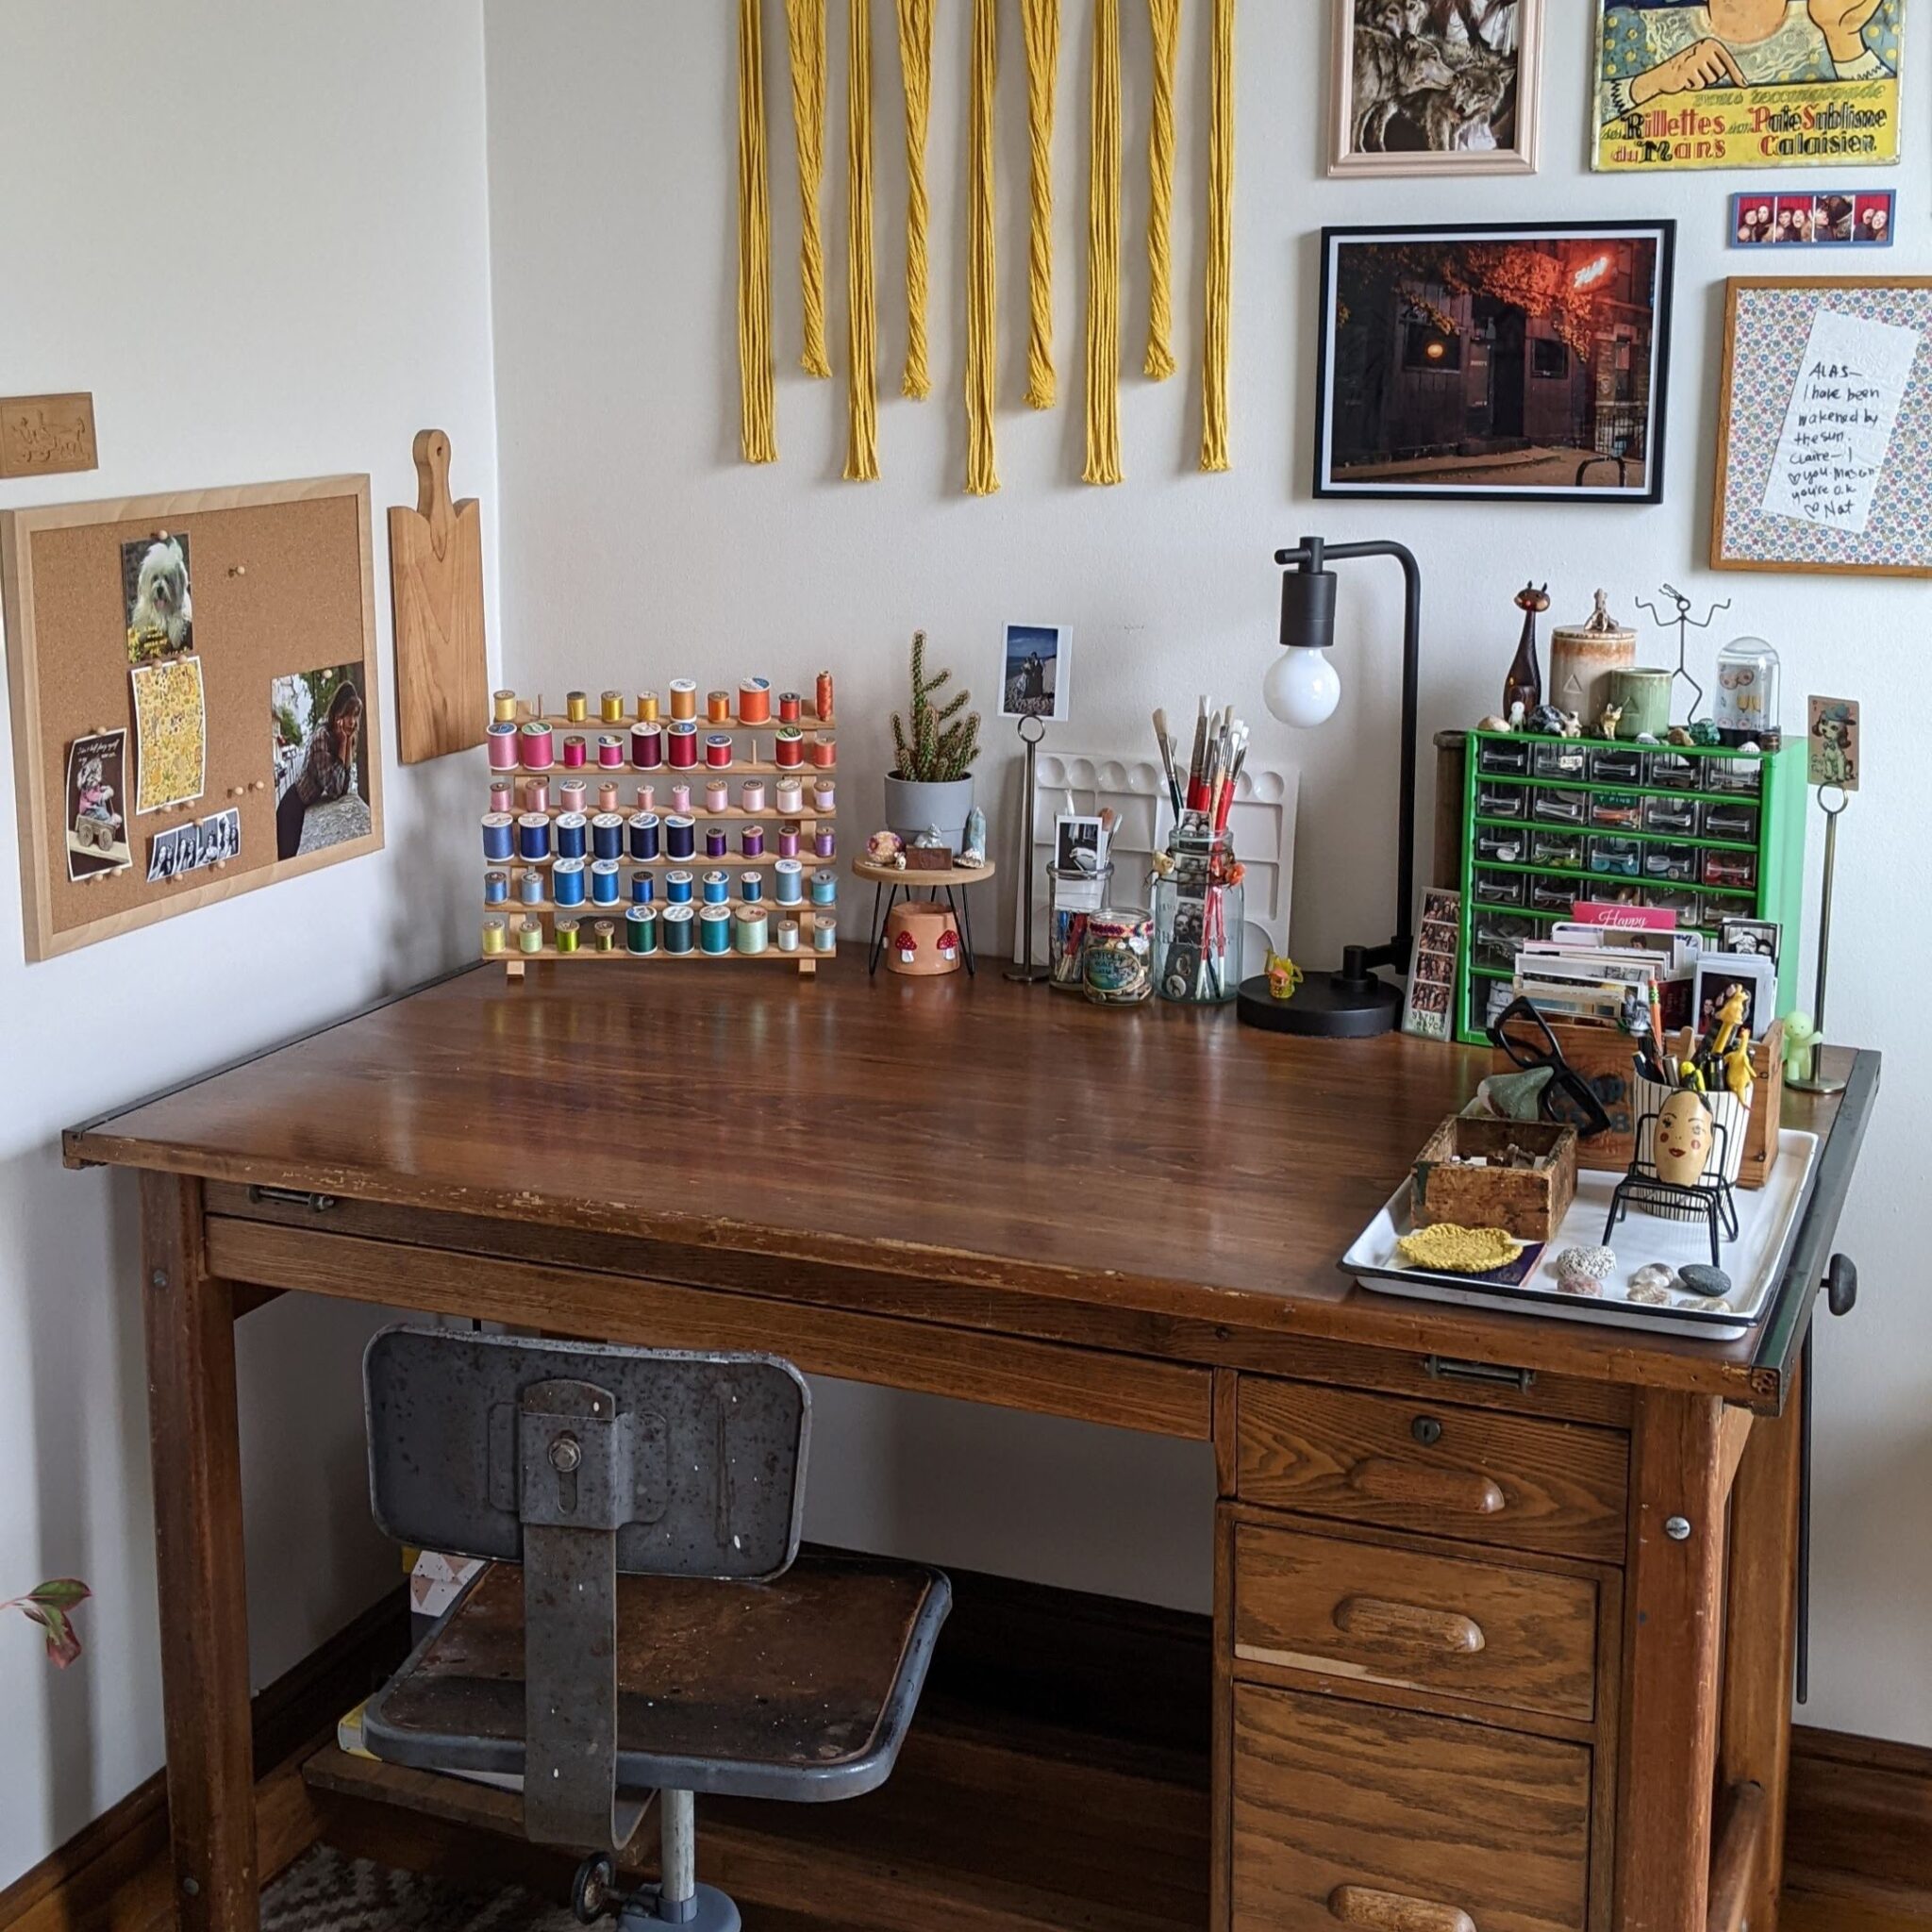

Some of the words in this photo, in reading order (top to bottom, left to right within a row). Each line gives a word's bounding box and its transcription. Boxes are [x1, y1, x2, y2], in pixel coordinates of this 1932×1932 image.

[1620, 108, 1725, 140] Rillettes
[1802, 102, 1887, 131] Sublime
[1610, 144, 1640, 162] du
[1634, 139, 1726, 163] Mans
[1811, 385, 1840, 401] have
[1846, 385, 1880, 401] been
[1863, 408, 1878, 427] by
[1794, 432, 1819, 447] the
[1824, 500, 1855, 518] Nat
[1598, 908, 1648, 928] Happy
